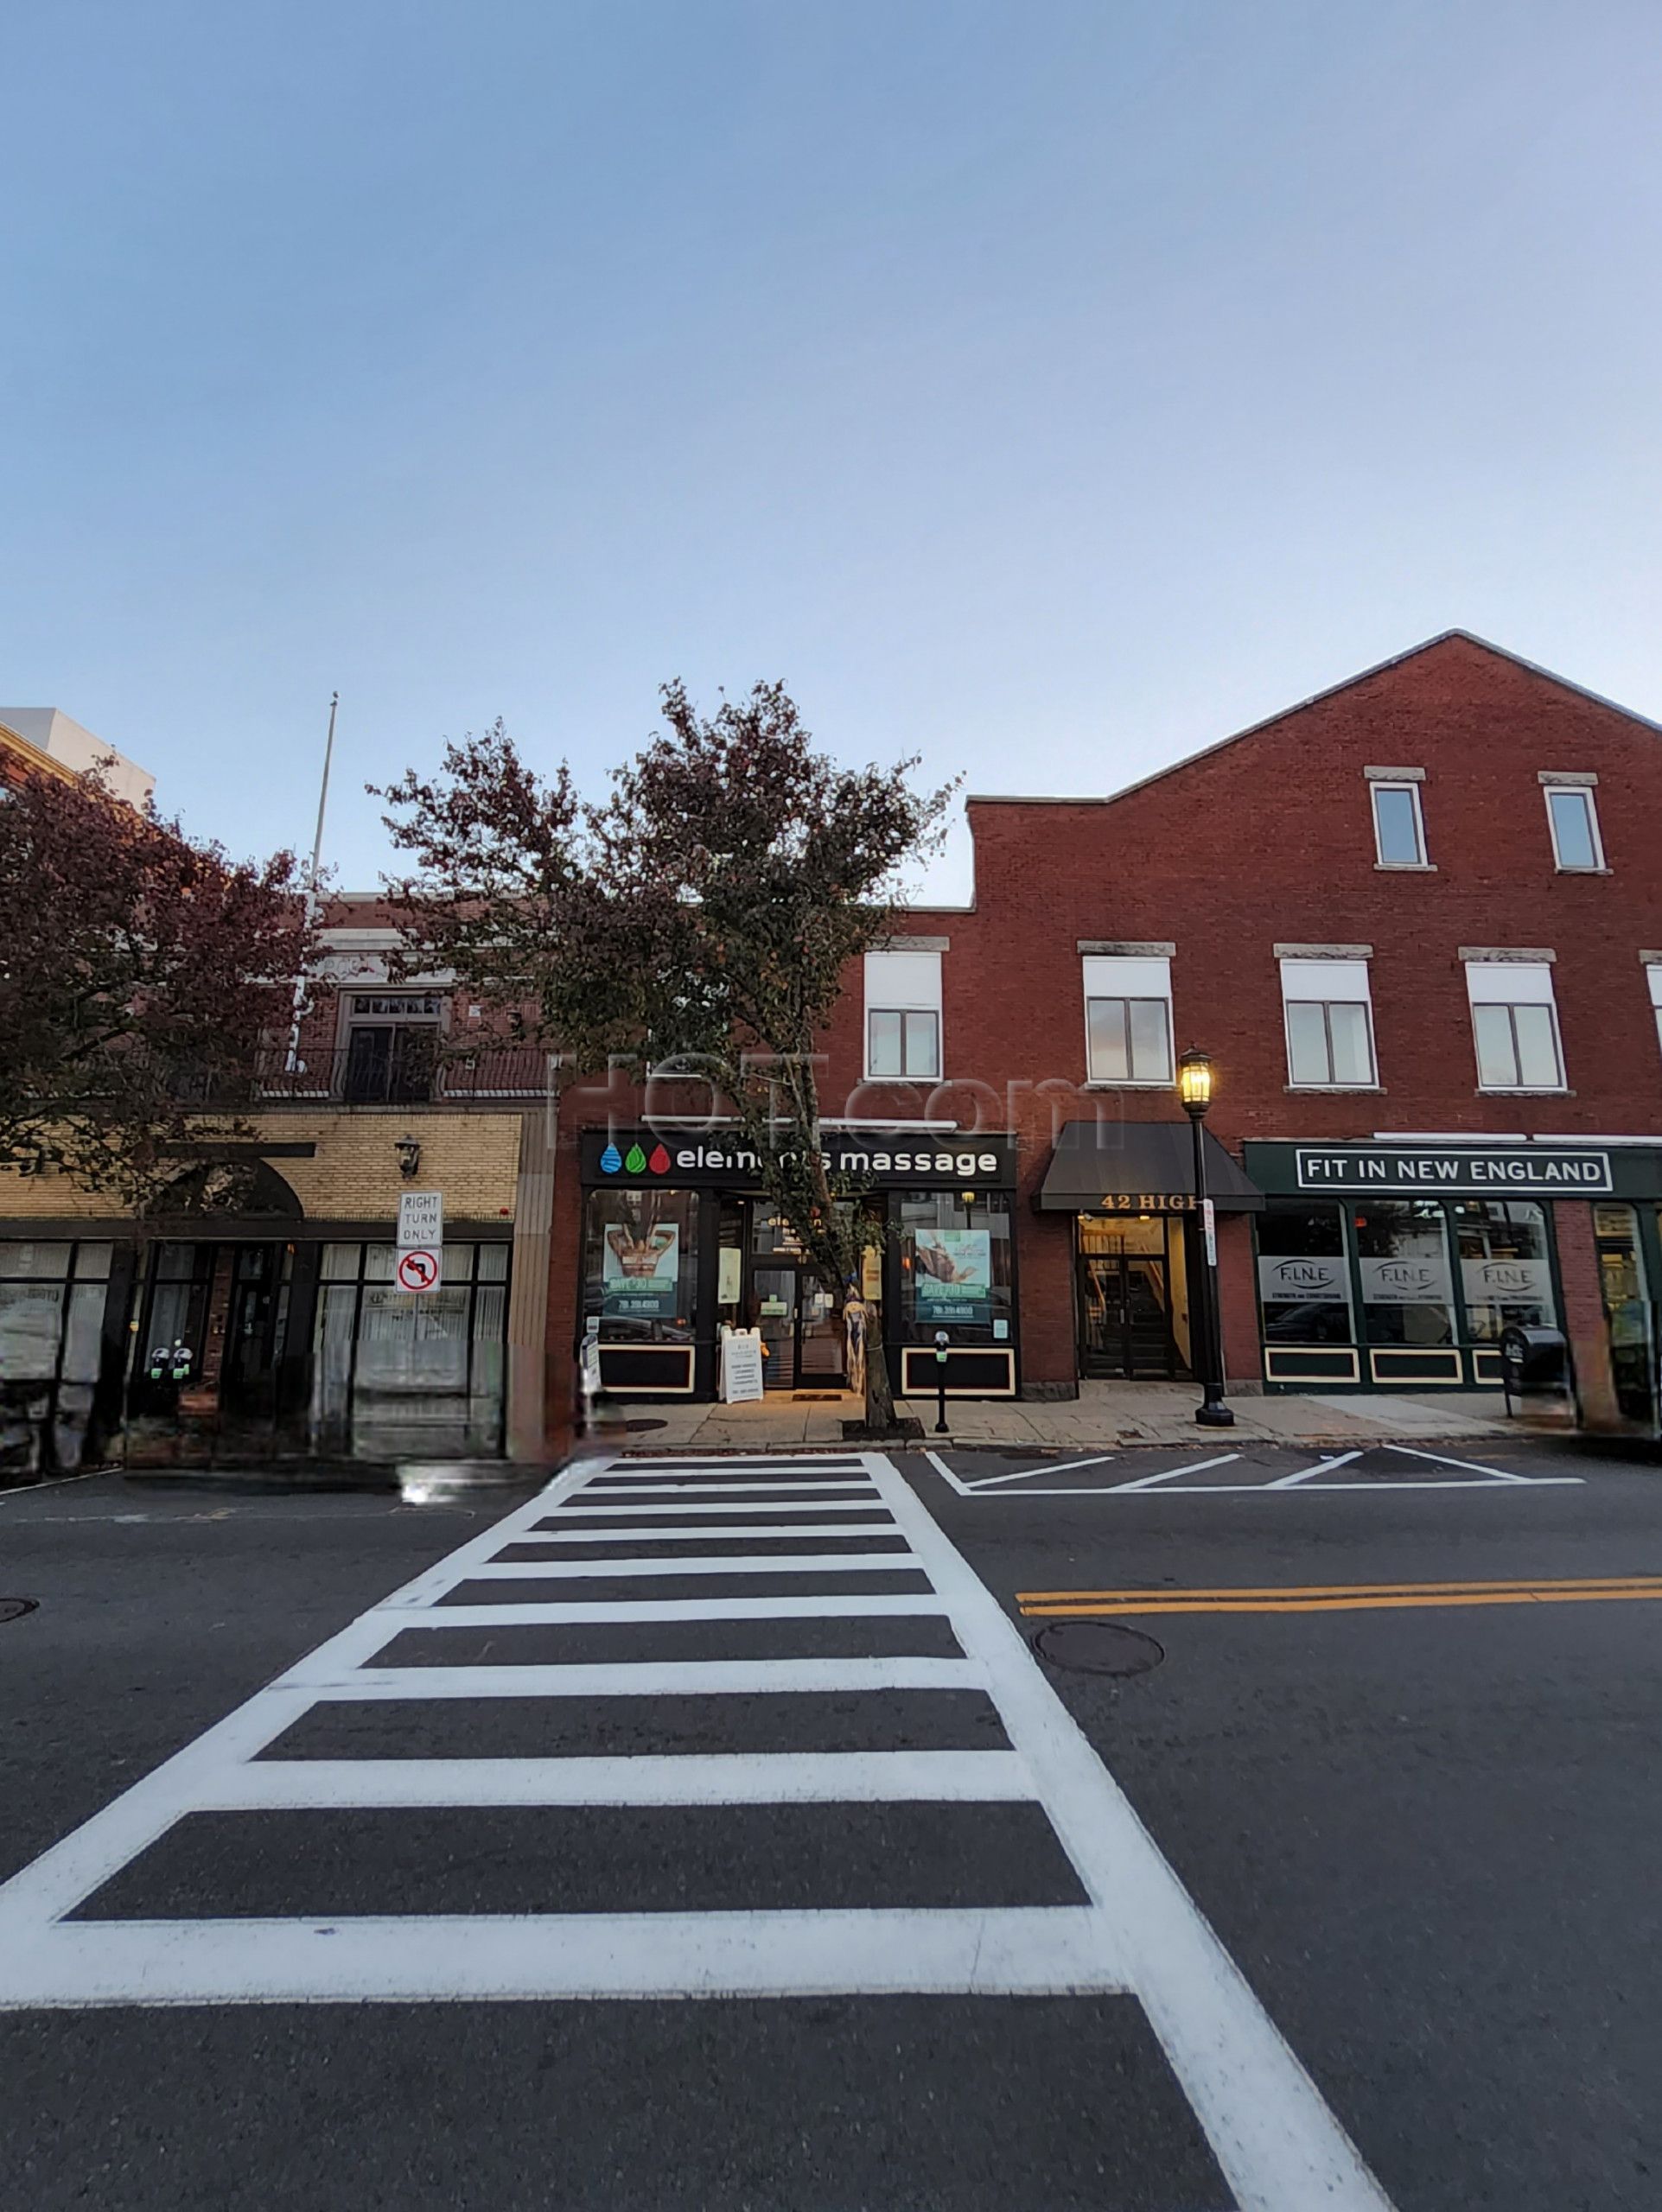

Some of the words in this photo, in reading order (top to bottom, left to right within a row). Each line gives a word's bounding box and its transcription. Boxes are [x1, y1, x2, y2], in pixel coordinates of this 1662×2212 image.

[677, 1146, 831, 1171] elemnts
[840, 1153, 997, 1177] massage
[1307, 1159, 1348, 1178] FIT
[1358, 1160, 1386, 1179] IN
[1397, 1160, 1460, 1180] NEW
[1469, 1161, 1602, 1181] ENGLAND
[404, 1196, 438, 1210] RIGHT
[1101, 1194, 1131, 1210] 42
[404, 1212, 437, 1224] TURN
[403, 1230, 436, 1240] ONLY
